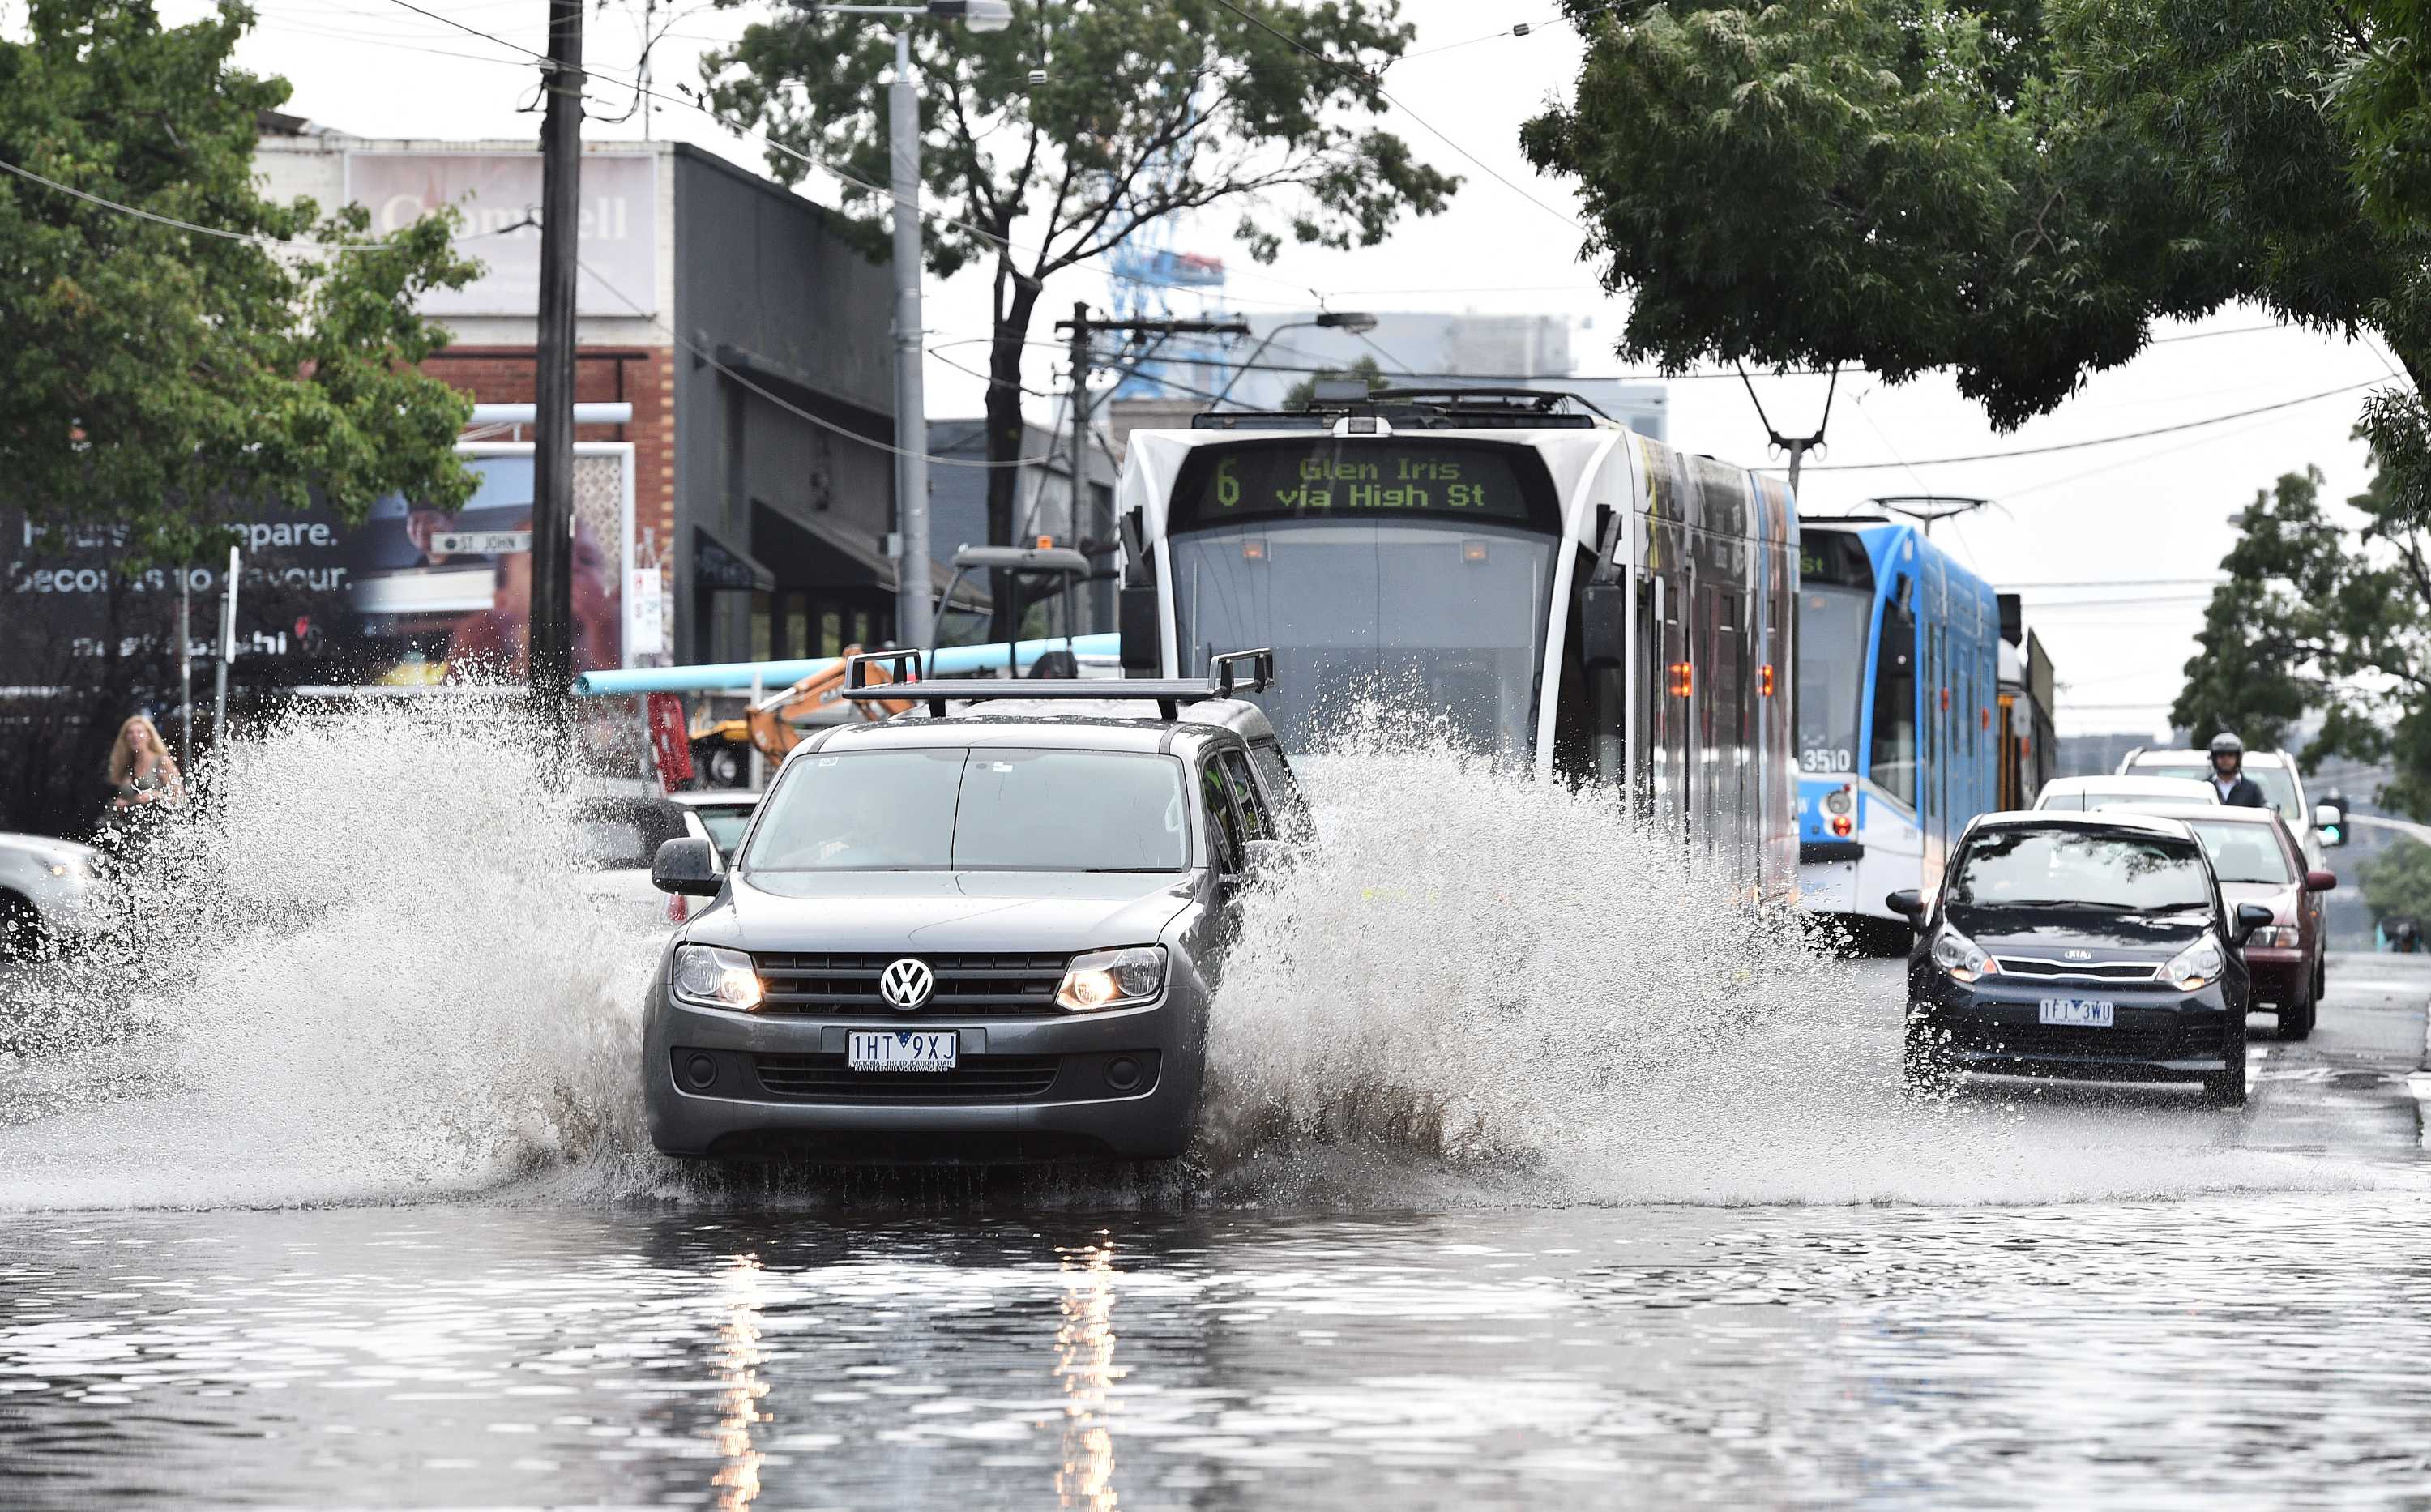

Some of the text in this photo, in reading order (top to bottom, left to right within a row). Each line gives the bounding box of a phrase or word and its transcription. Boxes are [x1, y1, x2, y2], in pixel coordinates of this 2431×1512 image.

[1299, 458, 1461, 480] Glen Iris
[1217, 456, 1240, 506] 6
[1275, 484, 1485, 506] via High St
[485, 535, 515, 549] JOHN
[1803, 749, 1851, 771] 3510
[2066, 950, 2091, 960] KIA
[881, 959, 933, 1006] VW
[855, 1036, 955, 1060] 1HT 9XJ
